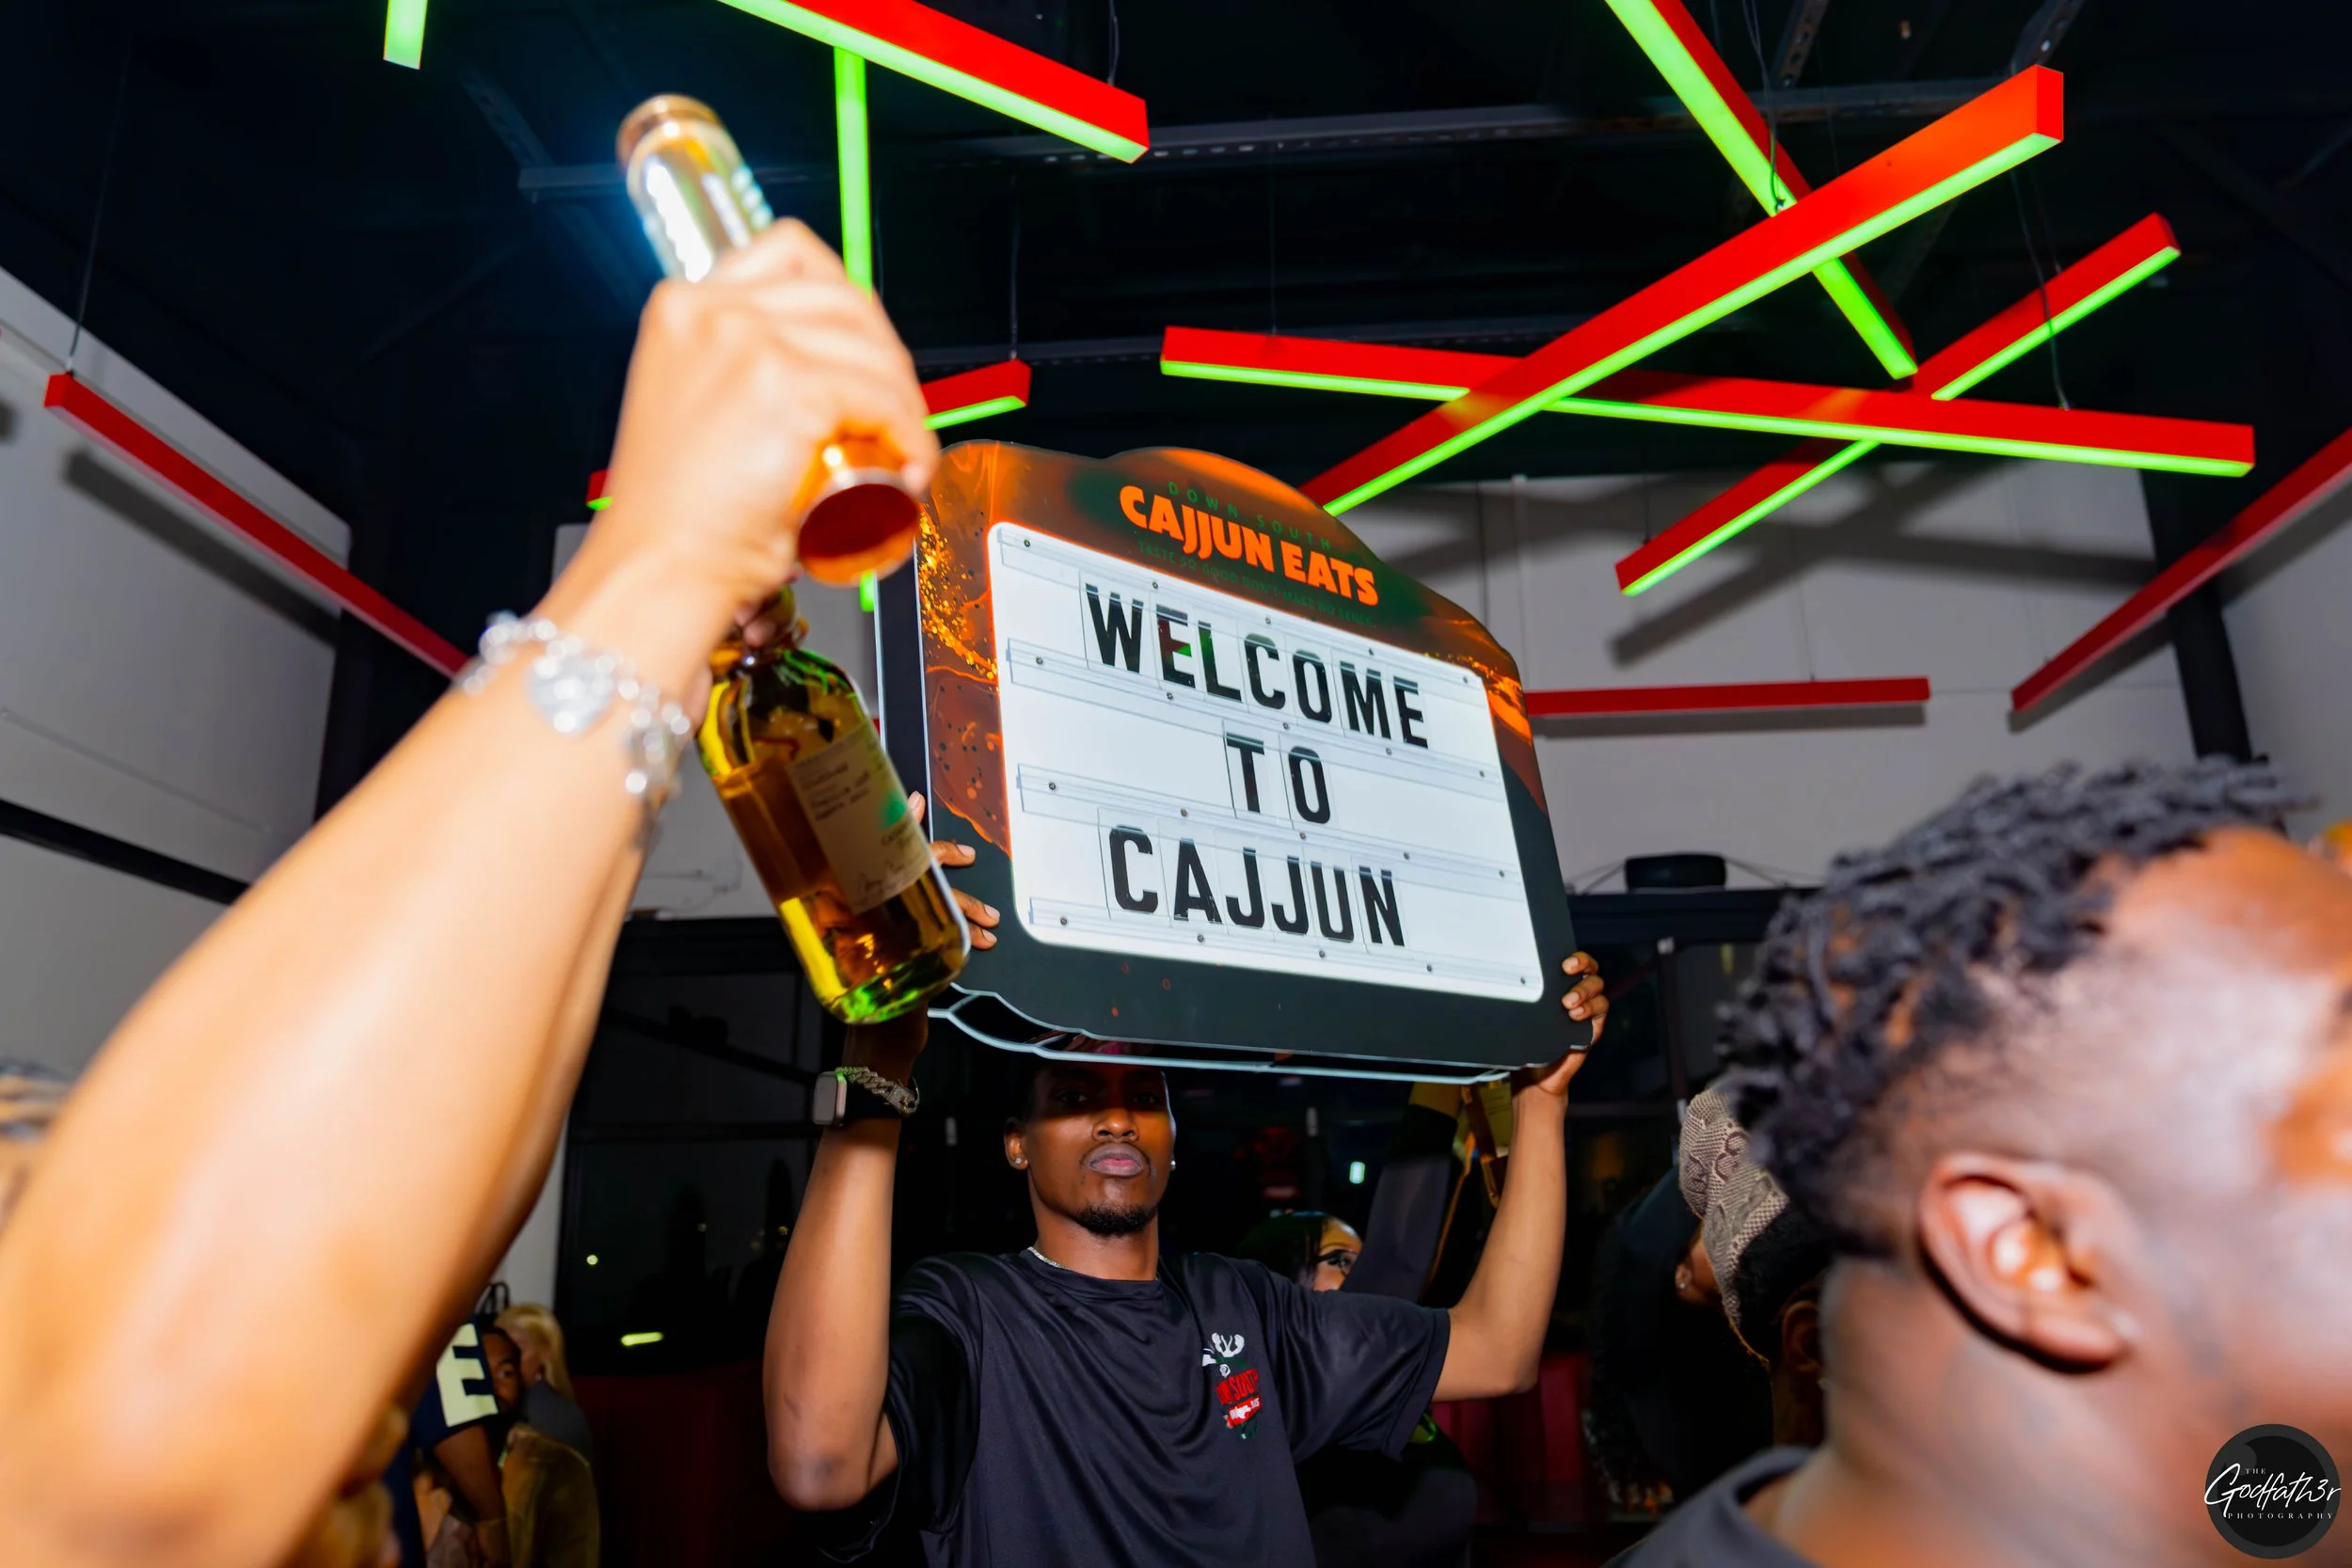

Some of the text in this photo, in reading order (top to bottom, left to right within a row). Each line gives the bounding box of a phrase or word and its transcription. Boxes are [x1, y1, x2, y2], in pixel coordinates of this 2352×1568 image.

[1120, 485, 1379, 606] CAJJUN EATS
[1137, 540, 1175, 564] TASTE
[1178, 556, 1198, 570] SO
[1200, 562, 1238, 583] GOOD
[1168, 481, 1331, 551] DOWN SOUTH
[1085, 582, 1429, 749] WELCOME
[1226, 732, 1331, 824] TO
[1109, 824, 1406, 947] CAJJUN
